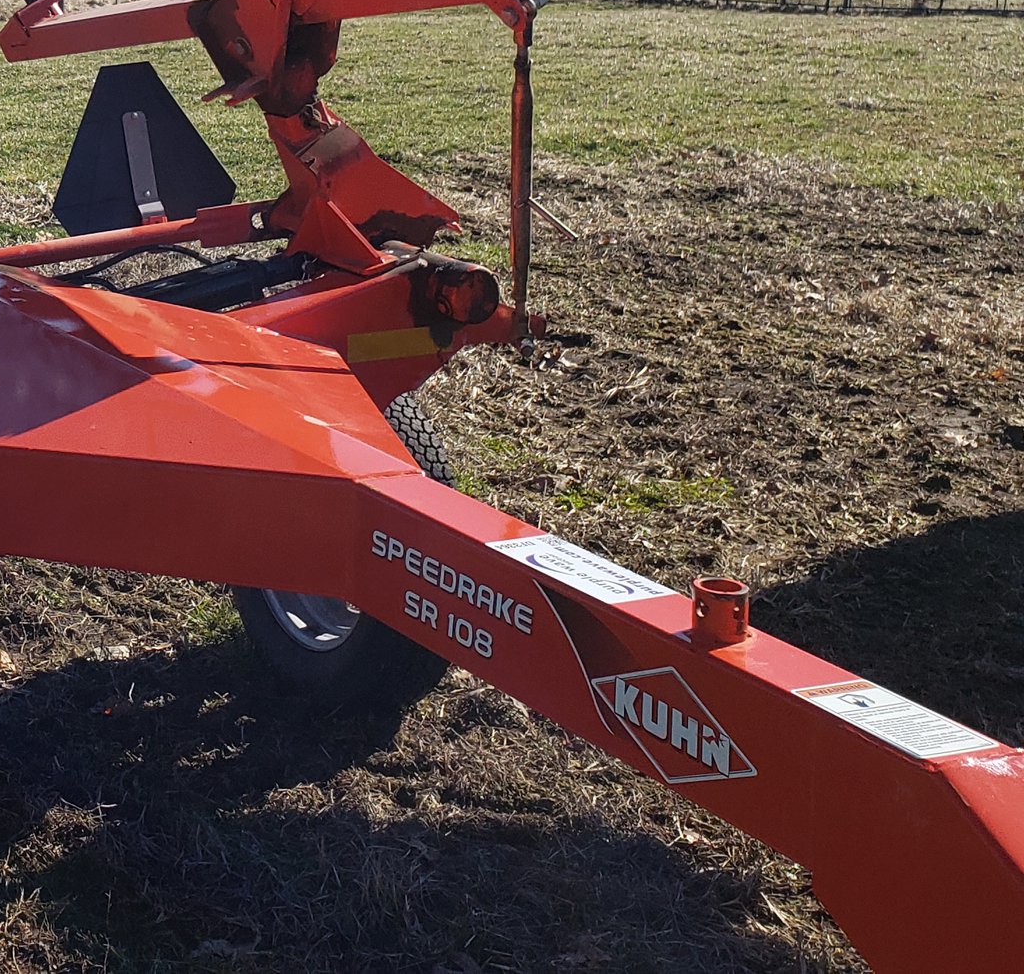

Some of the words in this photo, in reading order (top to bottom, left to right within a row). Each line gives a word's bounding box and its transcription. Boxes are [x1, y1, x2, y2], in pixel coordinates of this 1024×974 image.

[372, 530, 533, 634] SPEEDRAKE
[538, 554, 576, 572] wave
[554, 546, 665, 595] purplewave.com
[576, 572, 627, 594] purple
[404, 590, 438, 629] SR
[447, 613, 493, 658] 108
[614, 677, 731, 777] KUHN
